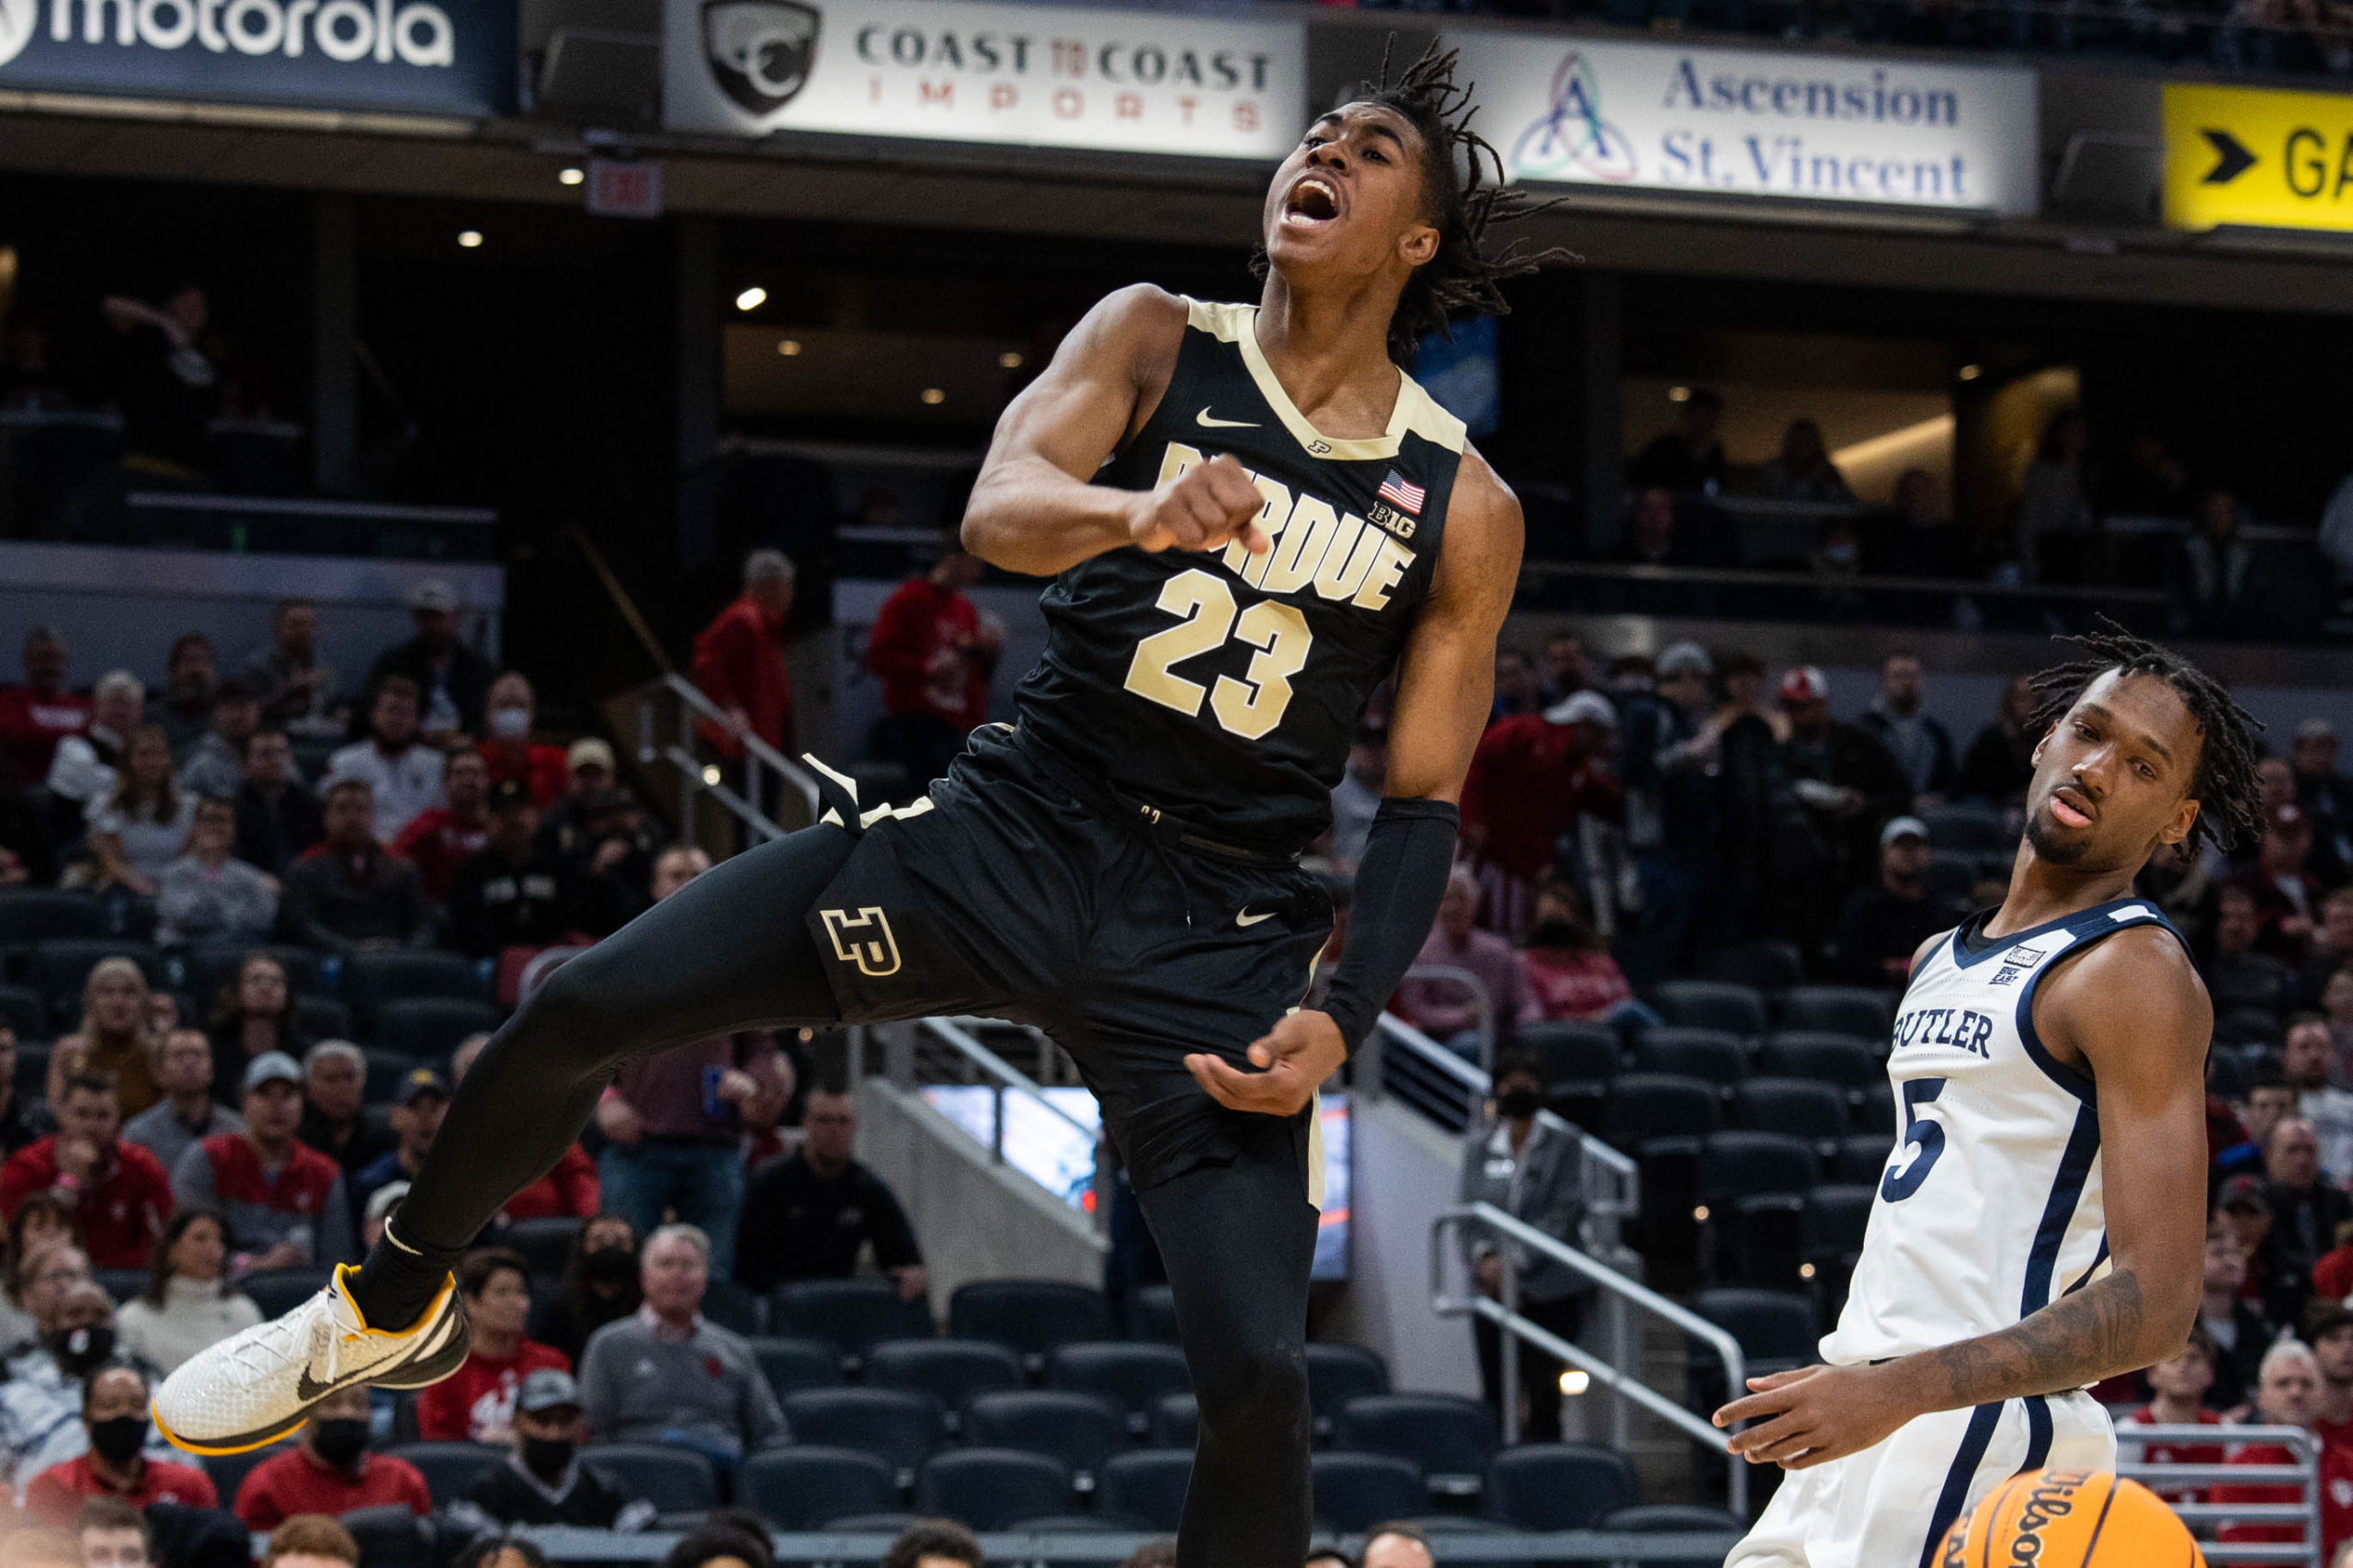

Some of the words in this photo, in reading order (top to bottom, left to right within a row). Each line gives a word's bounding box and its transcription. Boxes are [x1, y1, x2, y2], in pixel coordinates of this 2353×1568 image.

[50, 0, 455, 67] motorola
[855, 22, 1030, 74] COAST
[1098, 40, 1270, 91] COAST
[868, 77, 1263, 134] IMPORTS
[1661, 57, 1960, 127] Ascension
[1660, 131, 1736, 184] St.
[1744, 132, 1965, 197] Vincent
[1123, 568, 1313, 741] 23
[1881, 1077, 1947, 1203] 5
